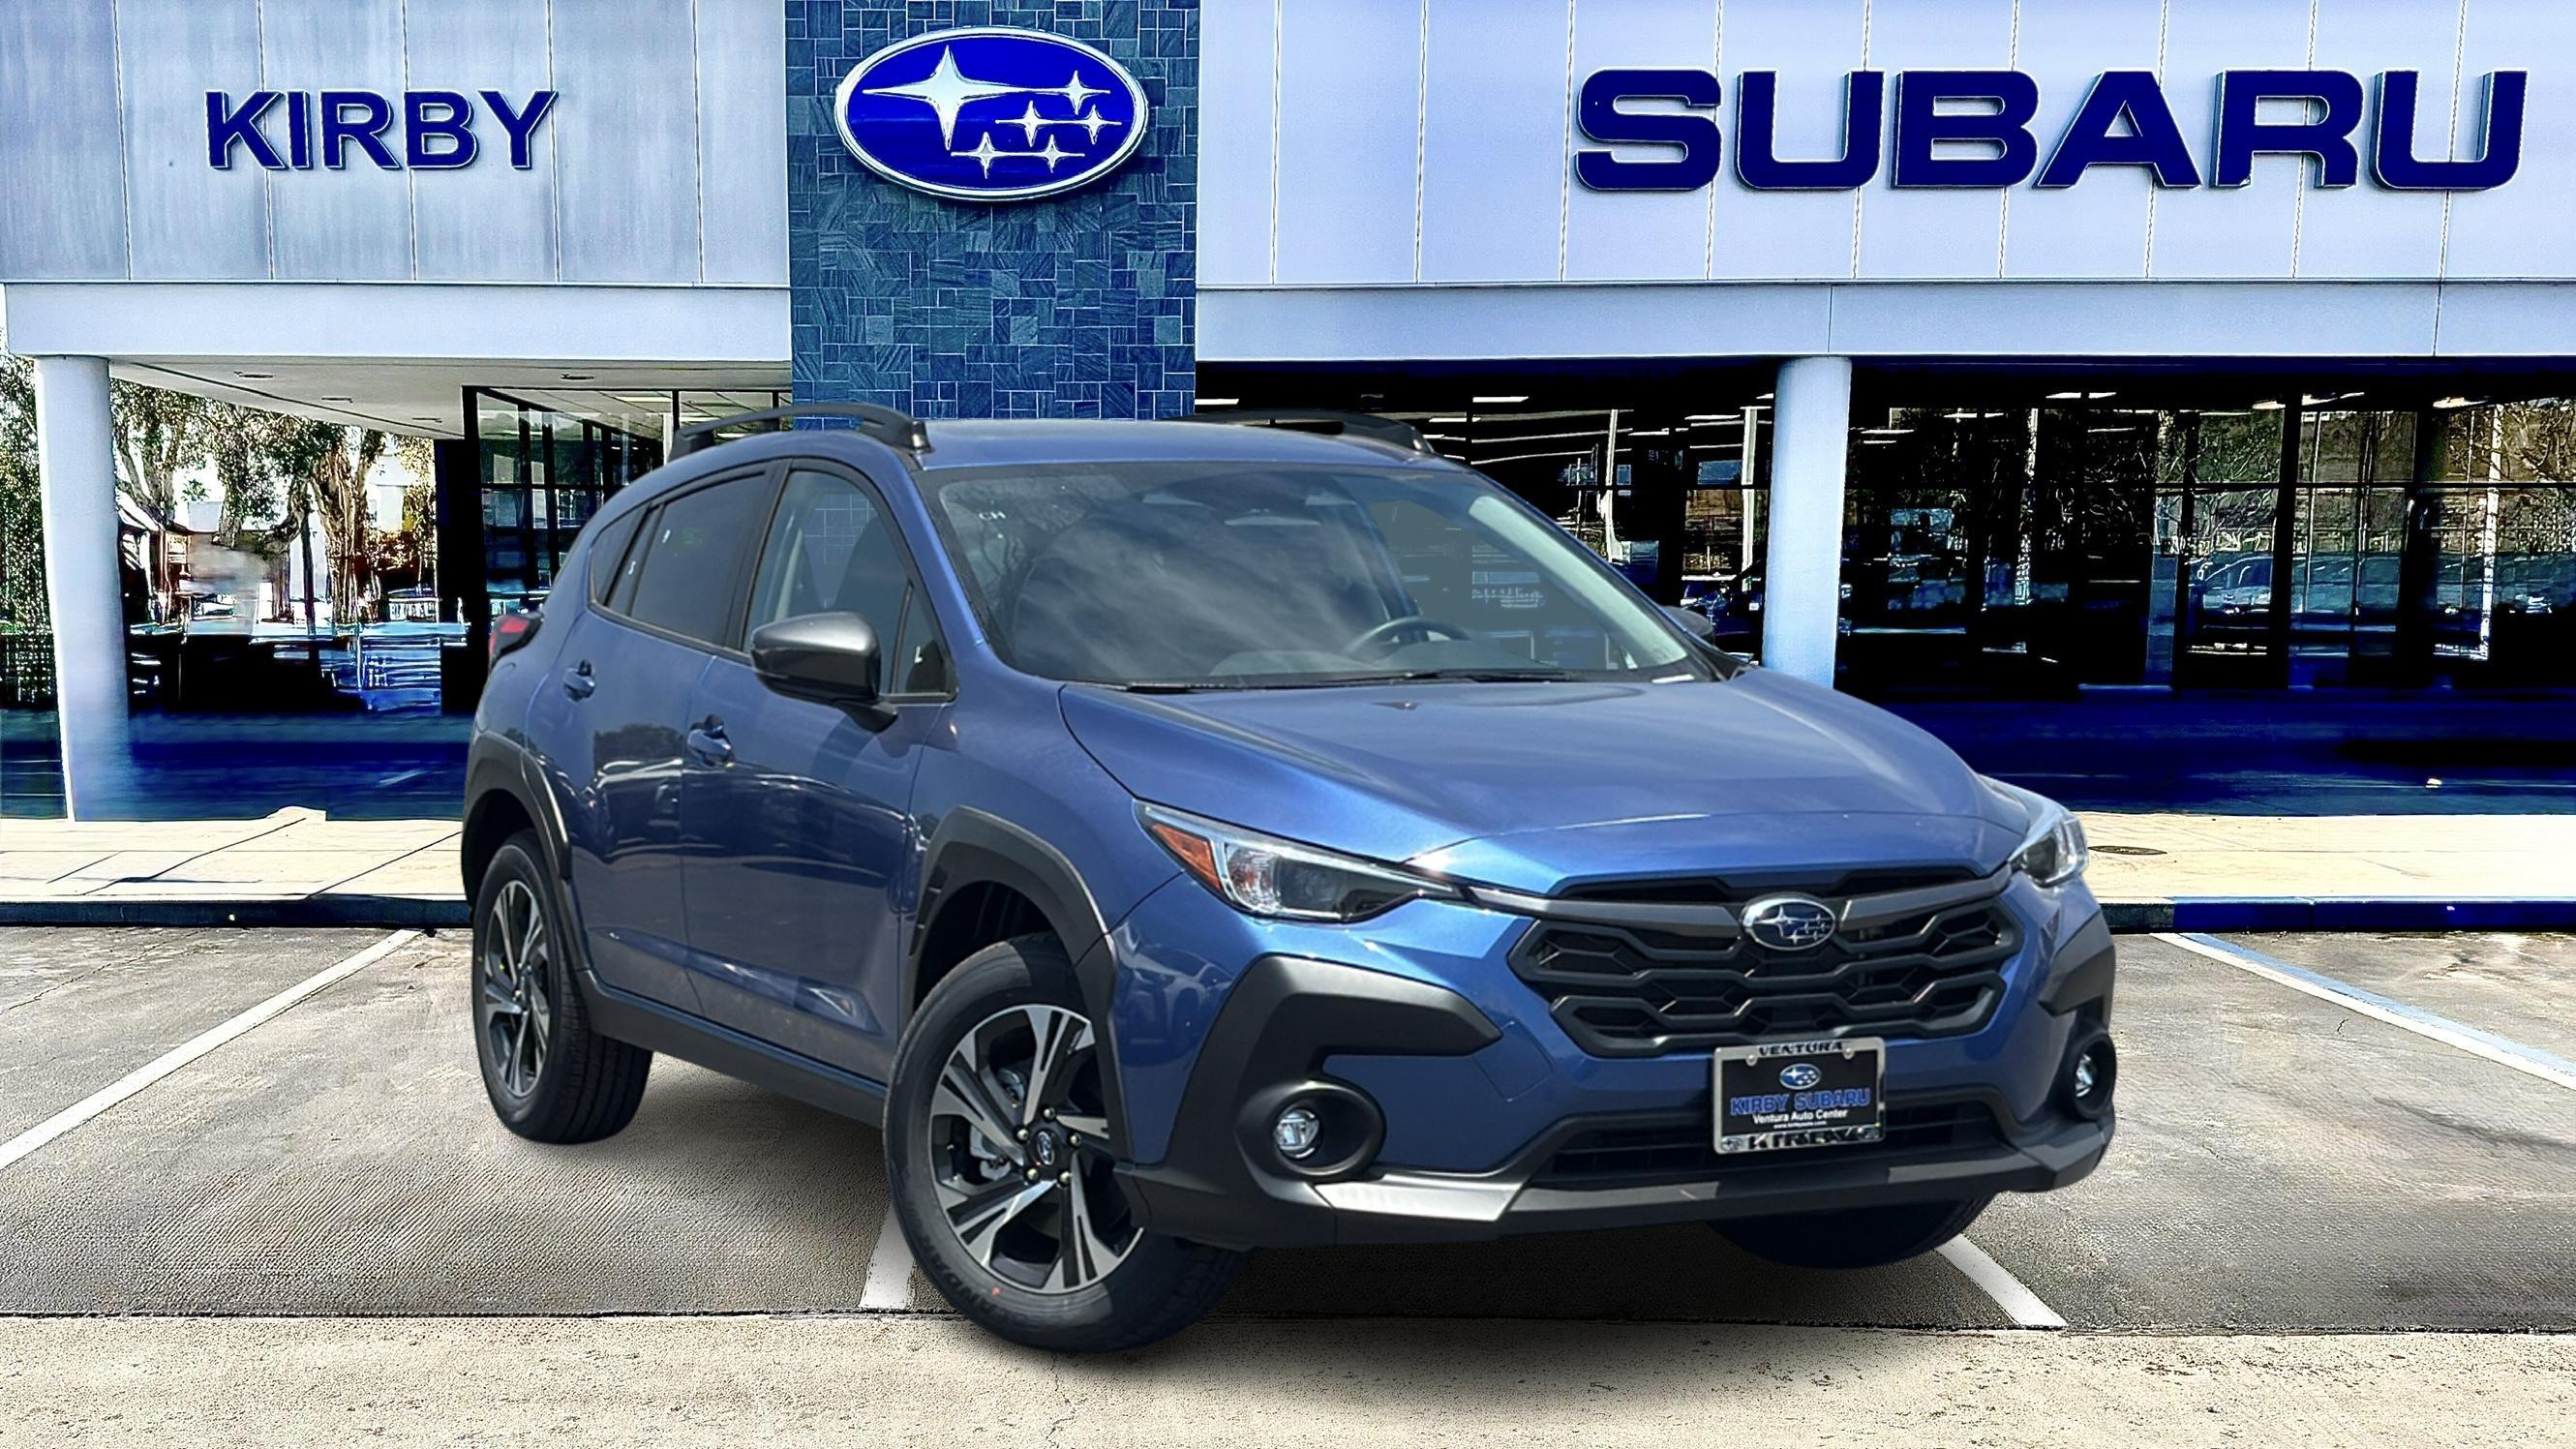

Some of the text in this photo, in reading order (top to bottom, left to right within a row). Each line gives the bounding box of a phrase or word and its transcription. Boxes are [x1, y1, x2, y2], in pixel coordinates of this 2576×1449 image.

[205, 91, 559, 170] KIRBY
[1575, 69, 2529, 192] SUBARU
[1759, 1041, 1843, 1056] VENTURA
[1731, 1089, 1870, 1115] KIRBY SUBARU
[1753, 1114, 1789, 1125] Ventura
[1791, 1110, 1813, 1121] Auto
[1816, 1108, 1848, 1119] Center
